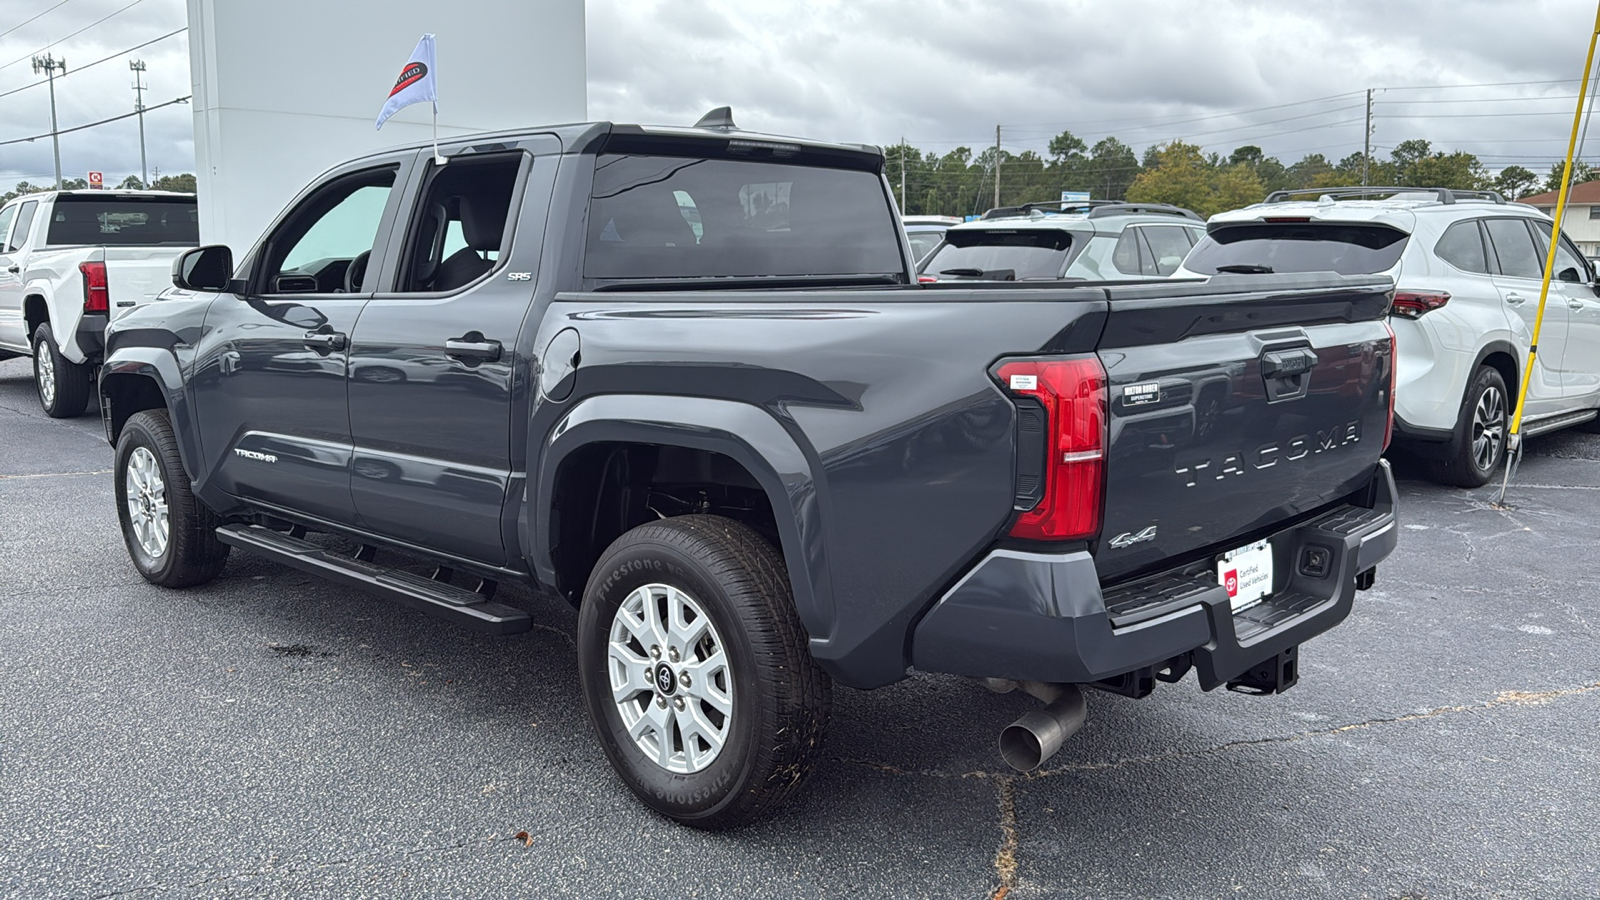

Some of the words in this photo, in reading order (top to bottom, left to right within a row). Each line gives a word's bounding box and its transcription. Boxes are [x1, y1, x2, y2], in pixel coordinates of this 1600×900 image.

[234, 448, 278, 463] TACOMA
[1174, 420, 1360, 488] TACOMA
[596, 558, 662, 601] Firestone
[1239, 563, 1259, 579] Certified
[1239, 577, 1252, 590] Used
[1251, 572, 1269, 585] Vehicles
